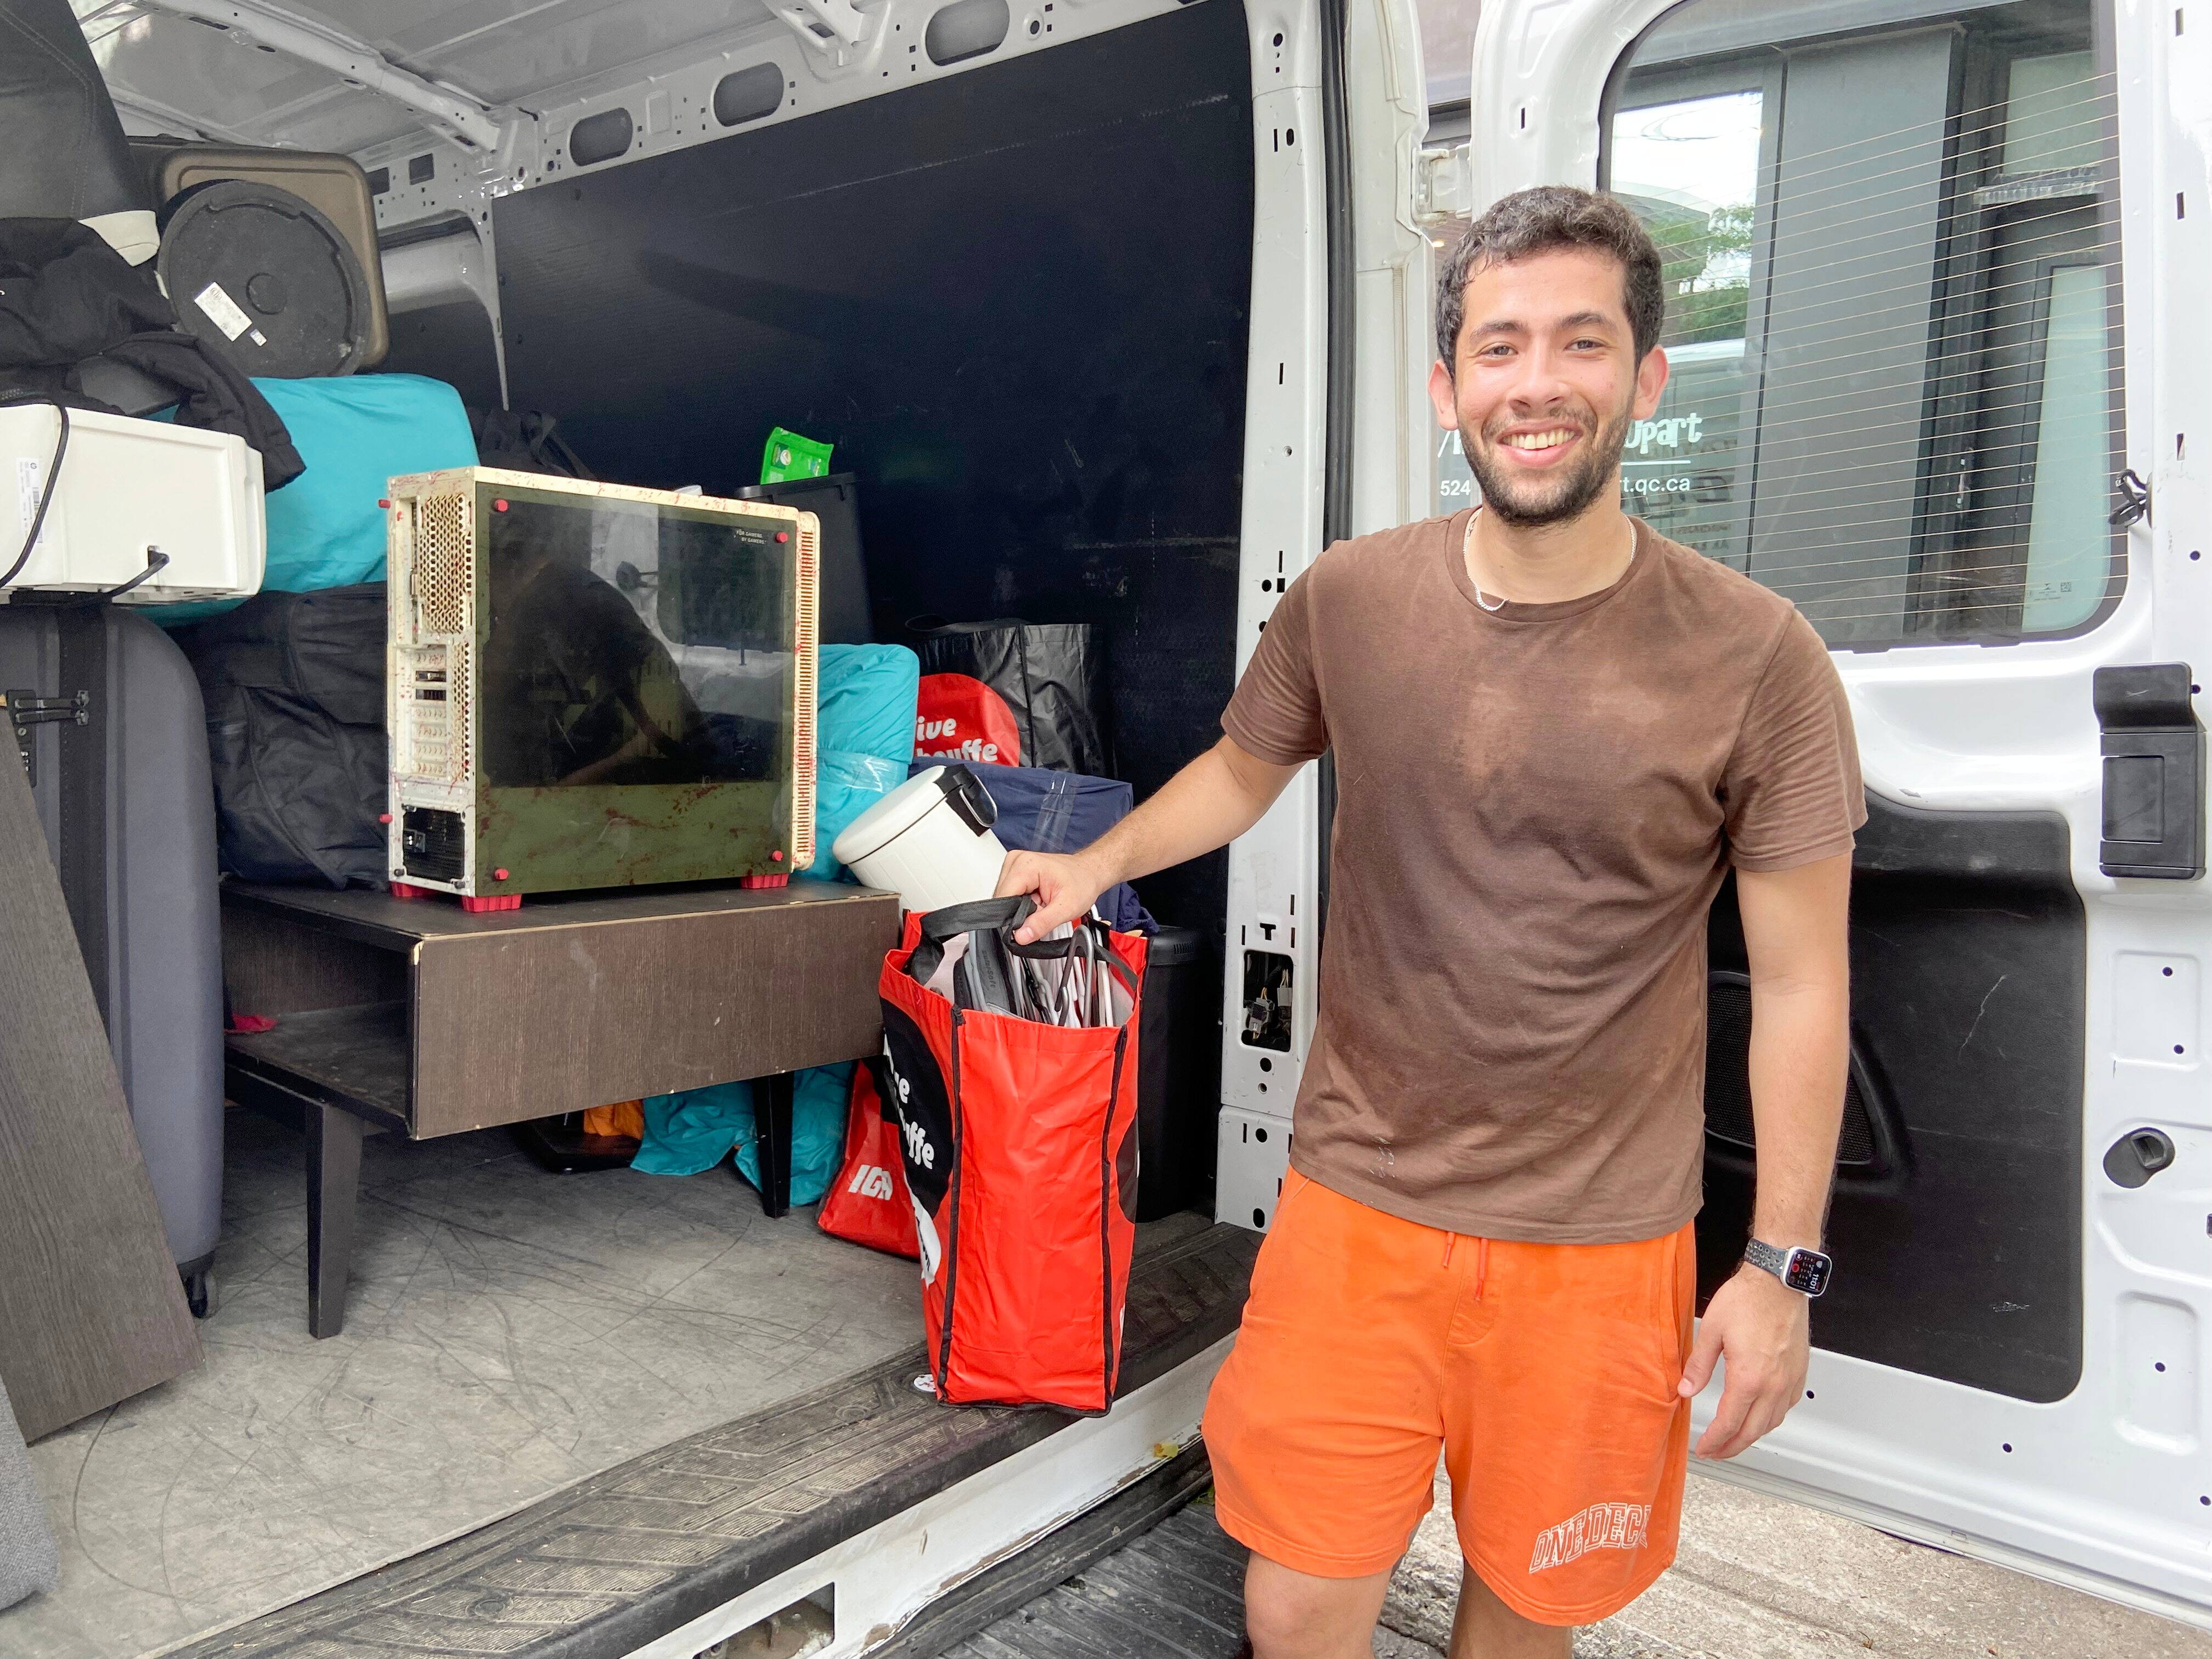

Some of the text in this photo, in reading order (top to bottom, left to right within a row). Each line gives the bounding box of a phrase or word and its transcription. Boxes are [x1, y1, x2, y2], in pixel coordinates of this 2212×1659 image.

[1440, 479, 1471, 496] 524
[1620, 477, 1691, 495] t.qc.ca
[917, 715, 957, 741] ive
[848, 1164, 893, 1201] IGA
